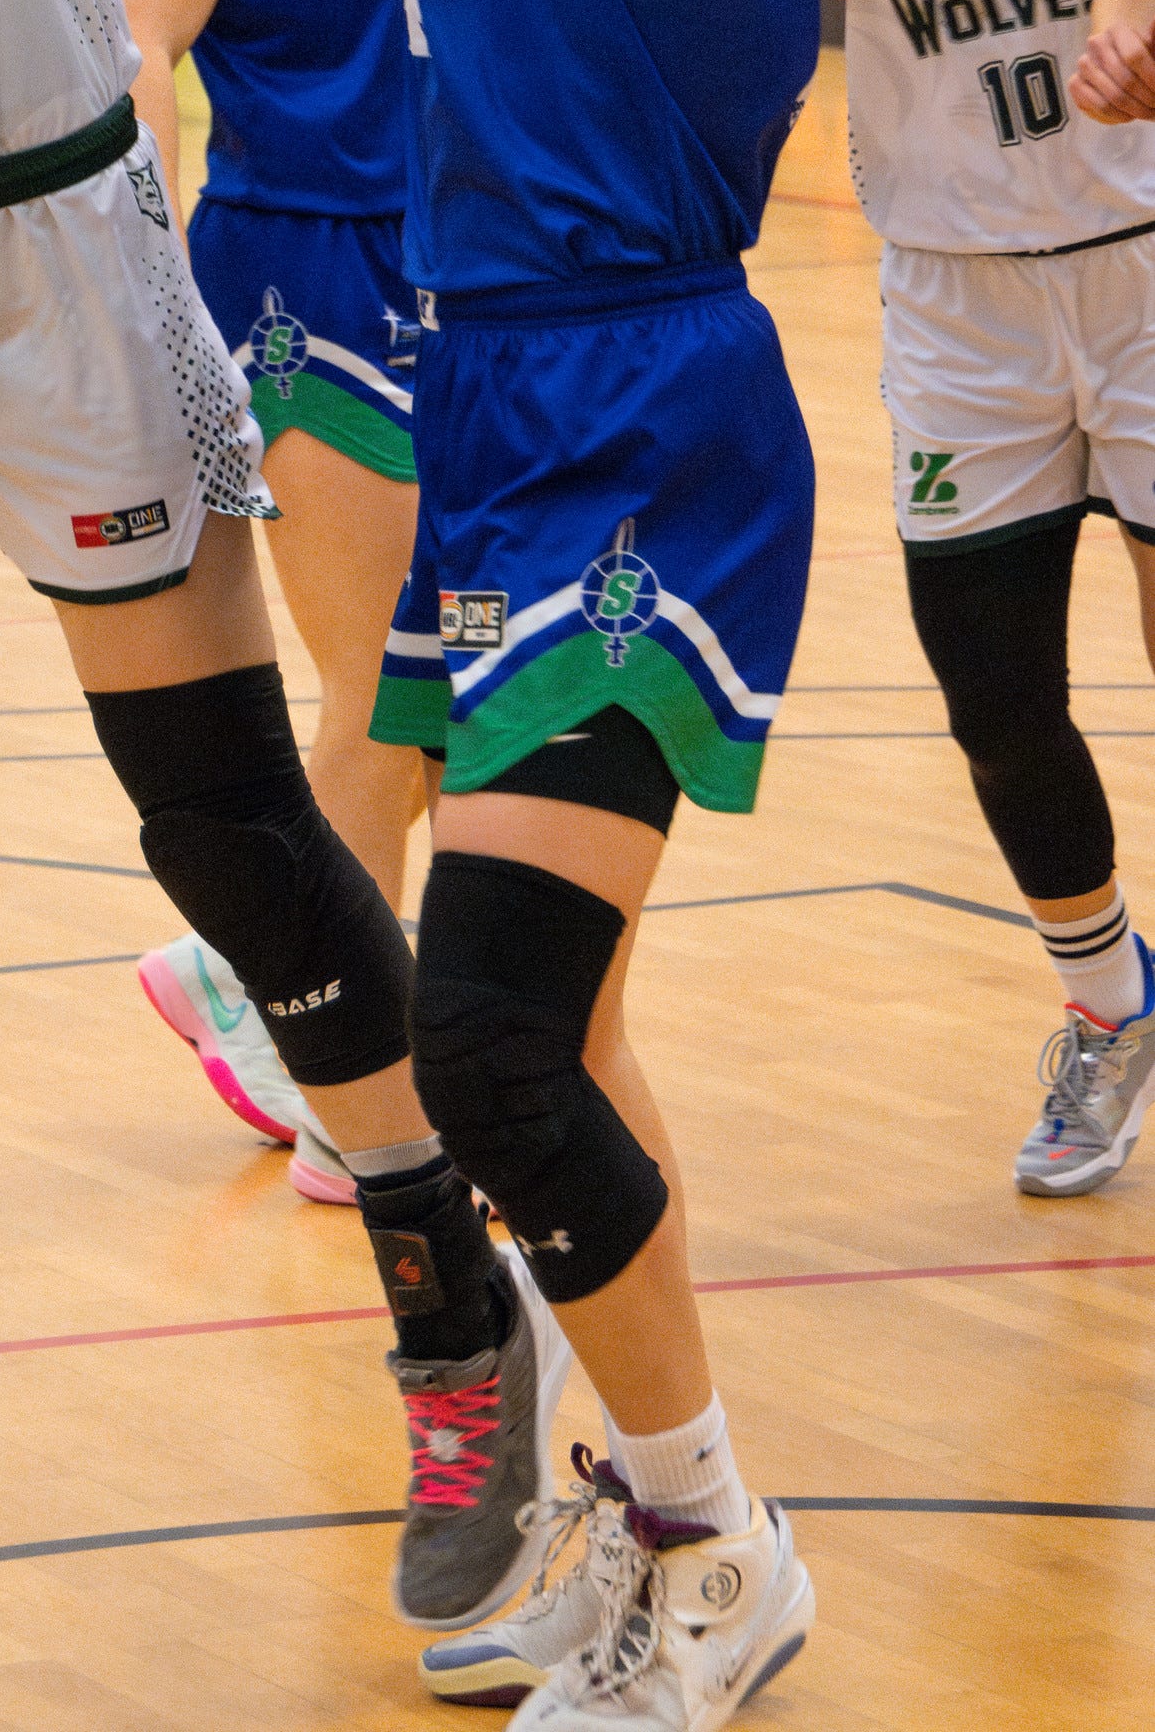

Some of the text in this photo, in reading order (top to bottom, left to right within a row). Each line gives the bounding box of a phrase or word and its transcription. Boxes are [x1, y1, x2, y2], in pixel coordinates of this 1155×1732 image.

[977, 52, 1070, 147] 10
[464, 601, 502, 627] ONE
[599, 571, 642, 618] S
